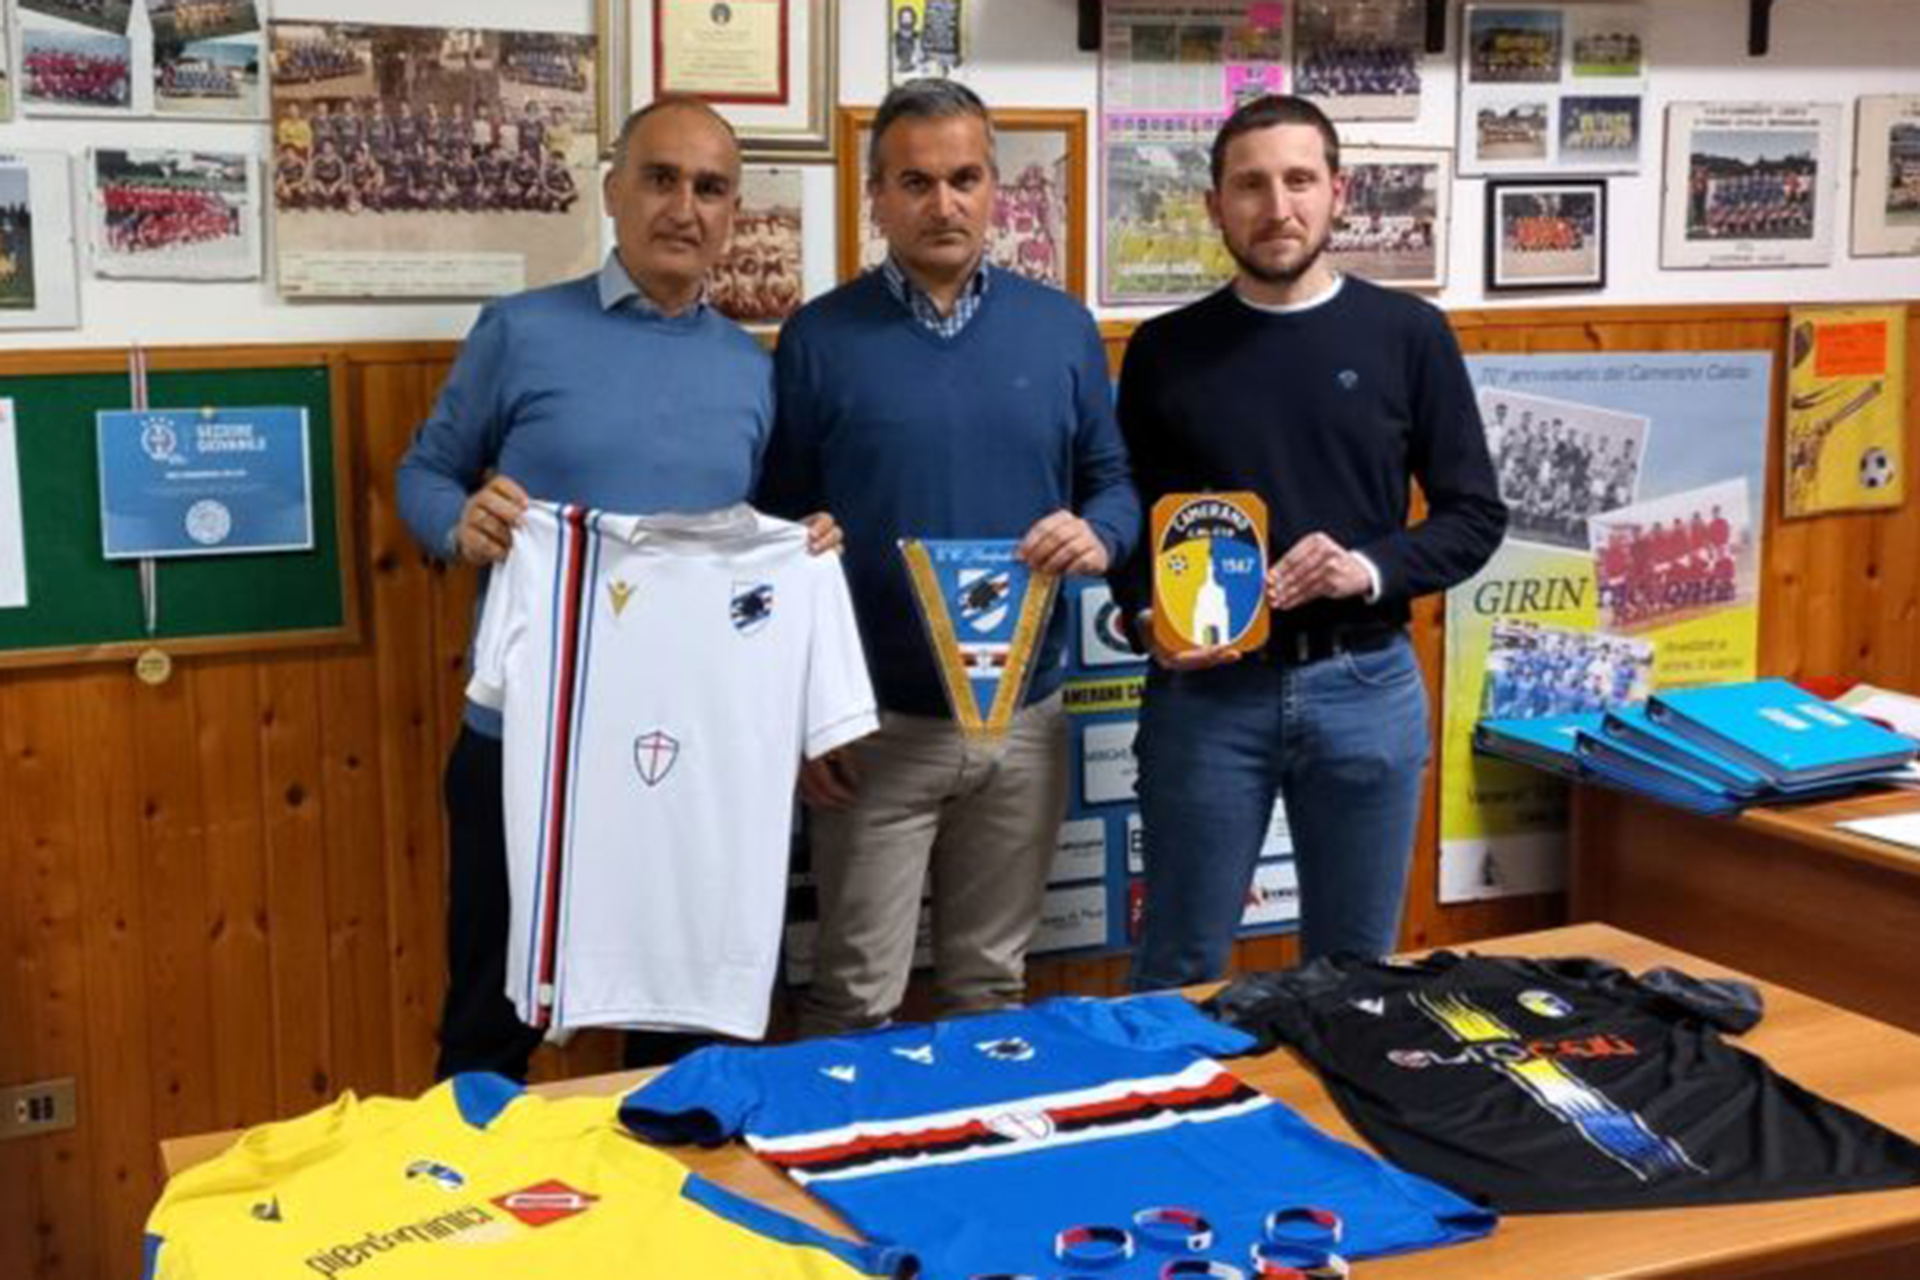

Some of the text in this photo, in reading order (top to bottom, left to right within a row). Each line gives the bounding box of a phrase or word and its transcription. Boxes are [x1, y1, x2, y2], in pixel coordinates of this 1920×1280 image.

[1173, 503, 1251, 533] CAMERANO
[1473, 577, 1589, 615] GIRIN
[1063, 685, 1123, 706] AMERANO
